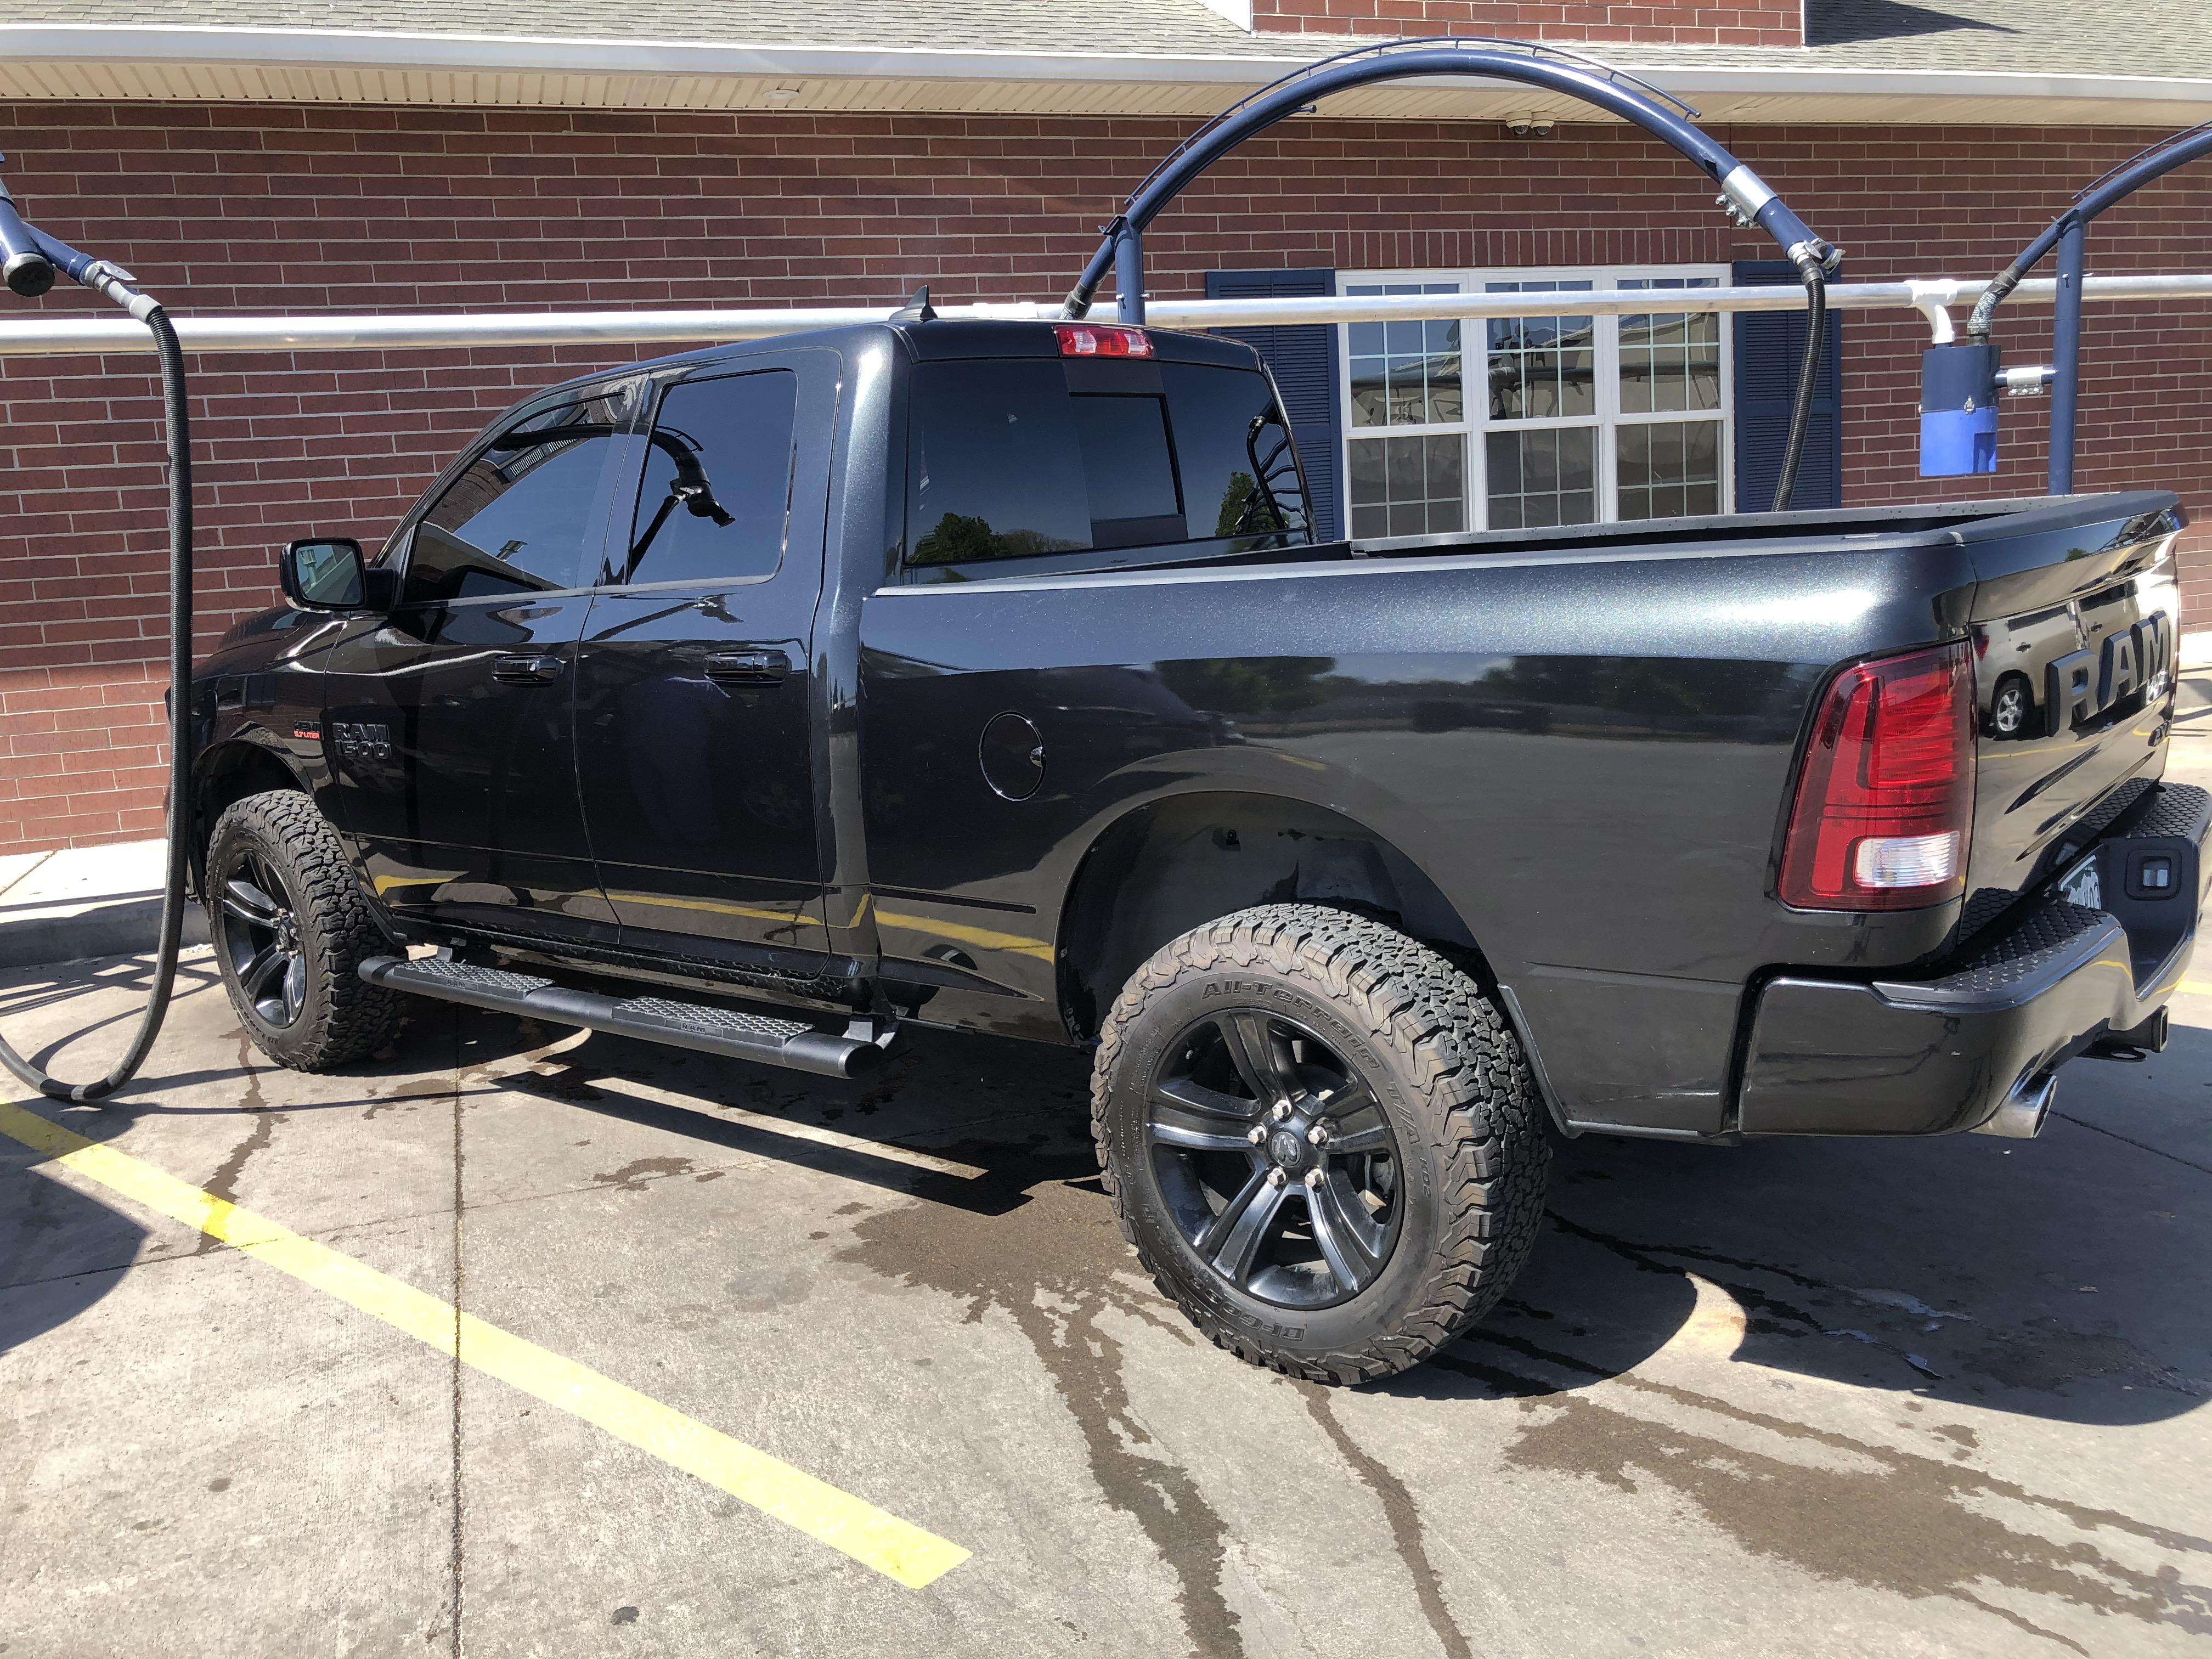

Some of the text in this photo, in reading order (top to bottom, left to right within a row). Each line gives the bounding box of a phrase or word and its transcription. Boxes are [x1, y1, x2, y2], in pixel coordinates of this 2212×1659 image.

[2045, 610, 2171, 737] RAM
[332, 722, 390, 741] RAM
[334, 740, 392, 759] 1500
[447, 979, 466, 989] RAM
[681, 1023, 706, 1034] RAM
[1201, 979, 1380, 1069] All-Terrain
